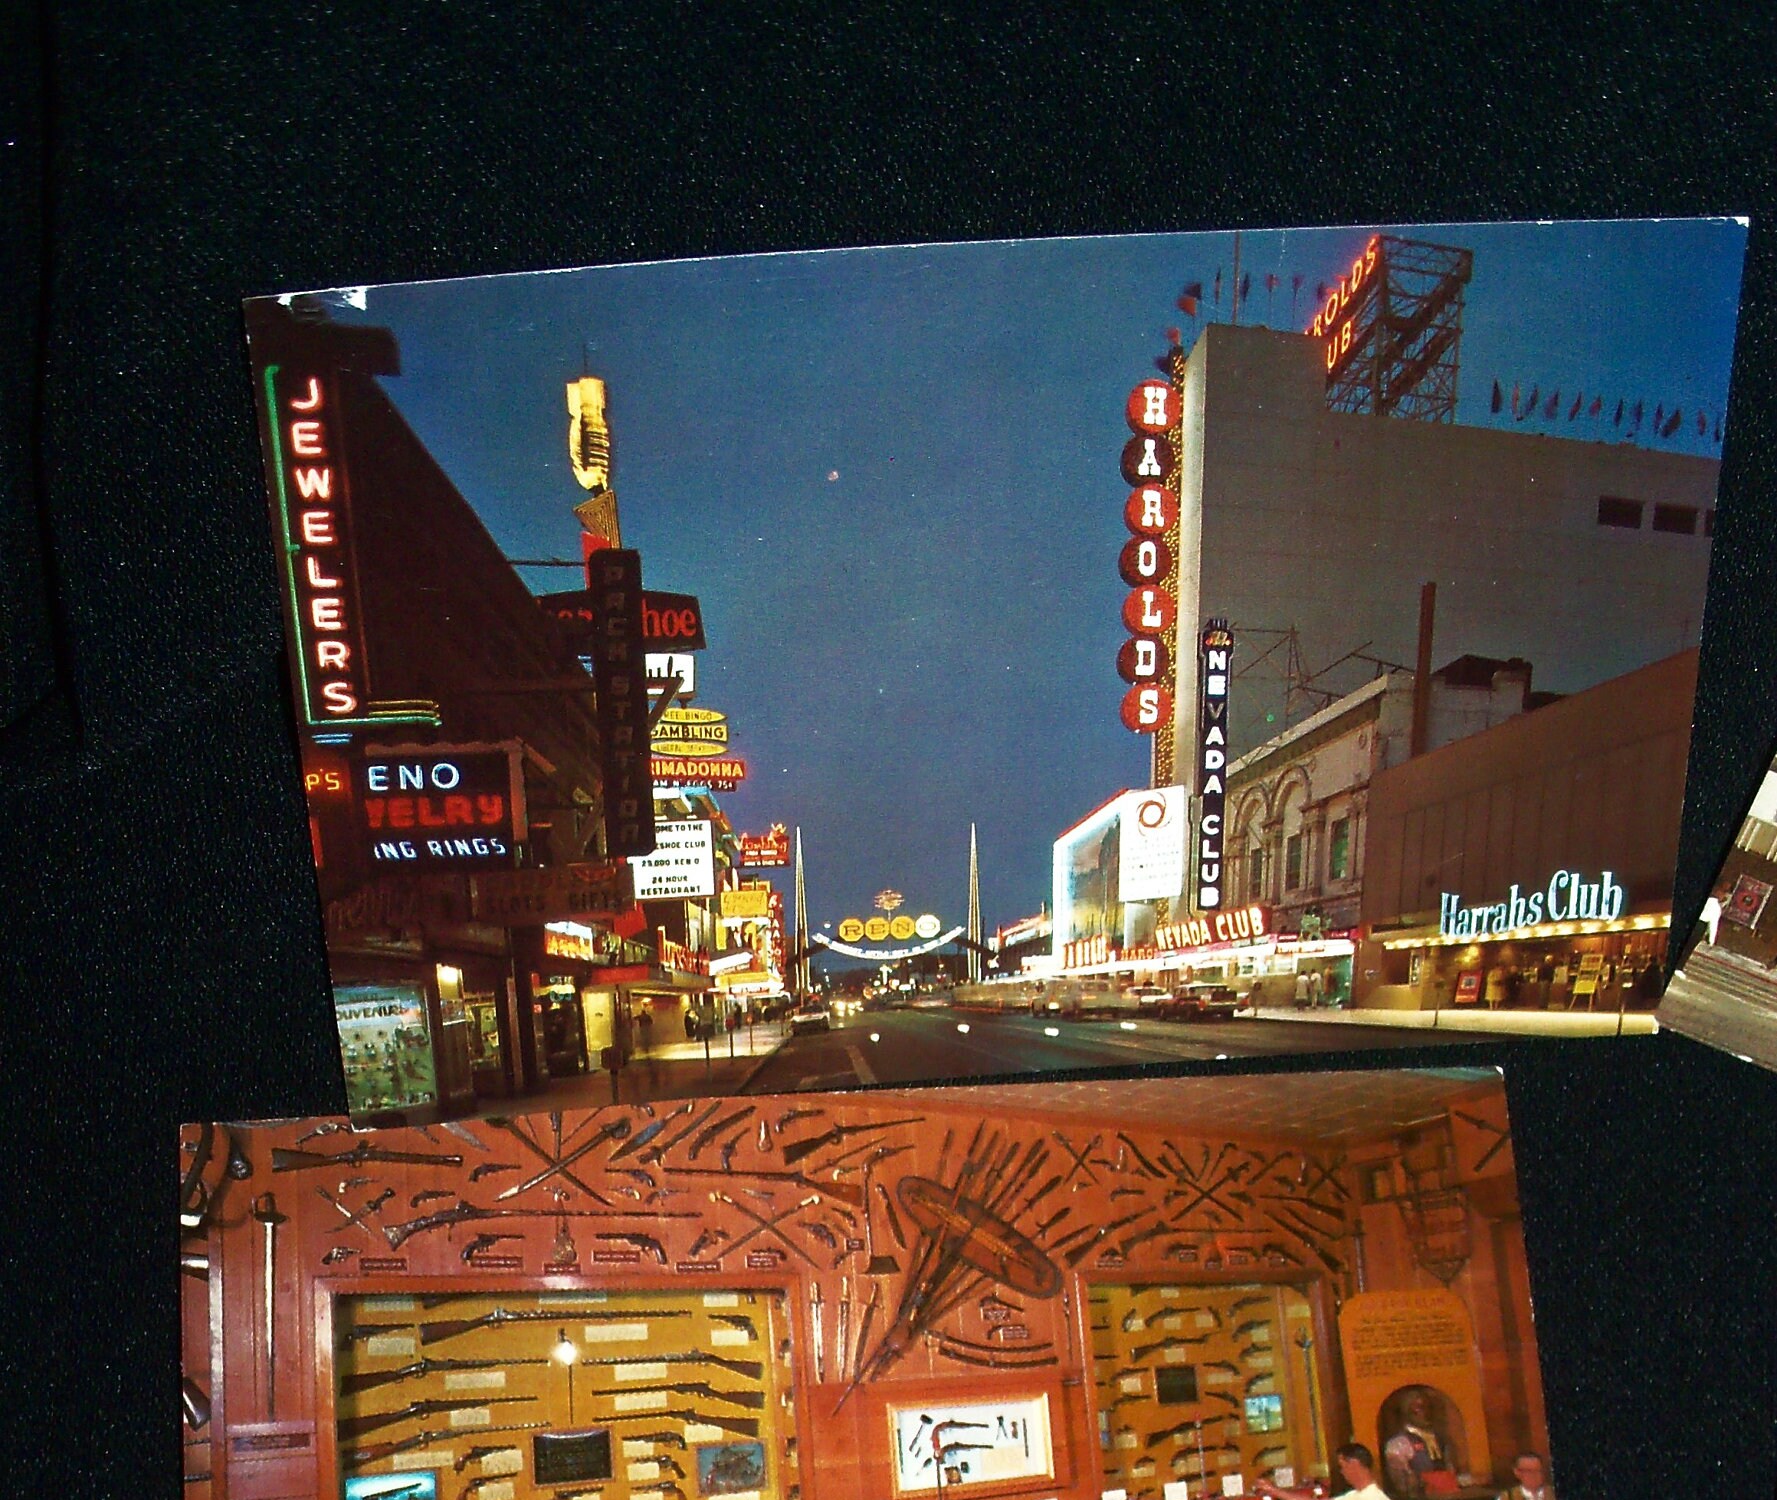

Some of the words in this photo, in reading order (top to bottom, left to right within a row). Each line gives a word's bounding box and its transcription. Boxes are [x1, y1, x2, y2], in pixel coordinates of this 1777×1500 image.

[292, 377, 357, 713] JEWELERS
[1136, 385, 1168, 726] HAROLDS
[1203, 650, 1227, 794] NEVADA
[367, 762, 460, 791] ENO
[687, 823, 704, 832] THE
[427, 837, 506, 858] RINGS
[684, 840, 706, 849] CLUB
[674, 857, 700, 866] KENO
[1199, 814, 1222, 908] CLUB
[640, 885, 701, 896] RESTAURANT
[665, 875, 688, 884] HOUR
[1439, 885, 1543, 938] Harrahs
[1547, 869, 1623, 922] Club
[842, 917, 939, 940] RENO
[1155, 918, 1211, 952] NEVADA
[1215, 906, 1265, 942] CLUB
